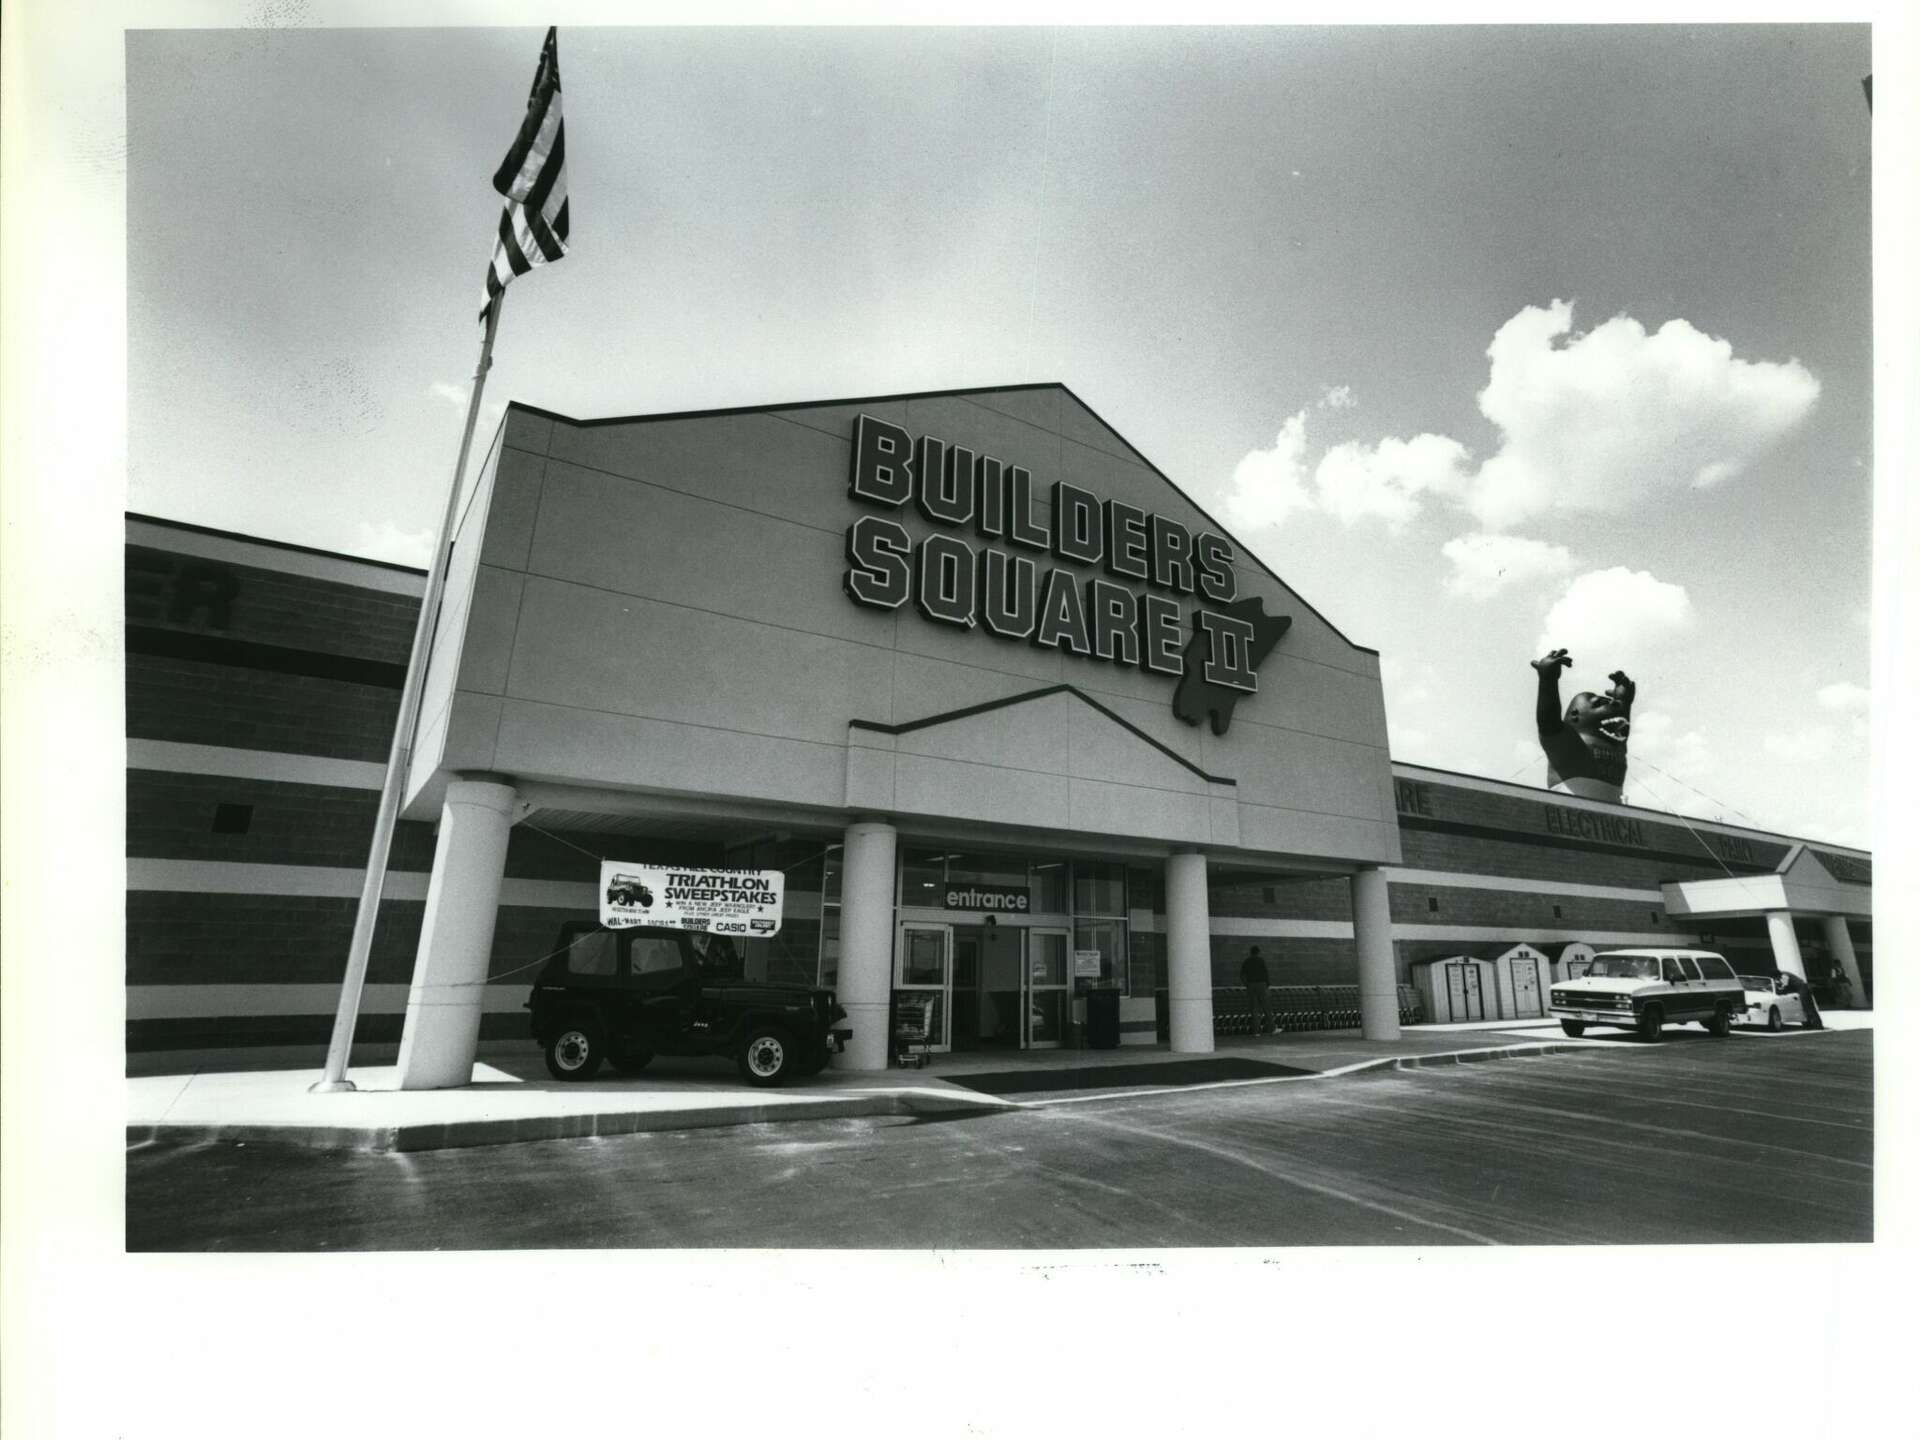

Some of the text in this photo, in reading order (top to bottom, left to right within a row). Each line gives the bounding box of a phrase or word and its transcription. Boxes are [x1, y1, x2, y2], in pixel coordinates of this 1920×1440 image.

[850, 413, 1238, 604] BUILDERS
[847, 515, 1258, 693] SQUARE II
[1544, 804, 1648, 849] ELECTRICAL
[666, 873, 769, 891] TRIATHLON
[664, 887, 777, 905] SWEEPSTAKES
[947, 888, 1028, 909] entrance
[716, 922, 747, 933] CASIO
